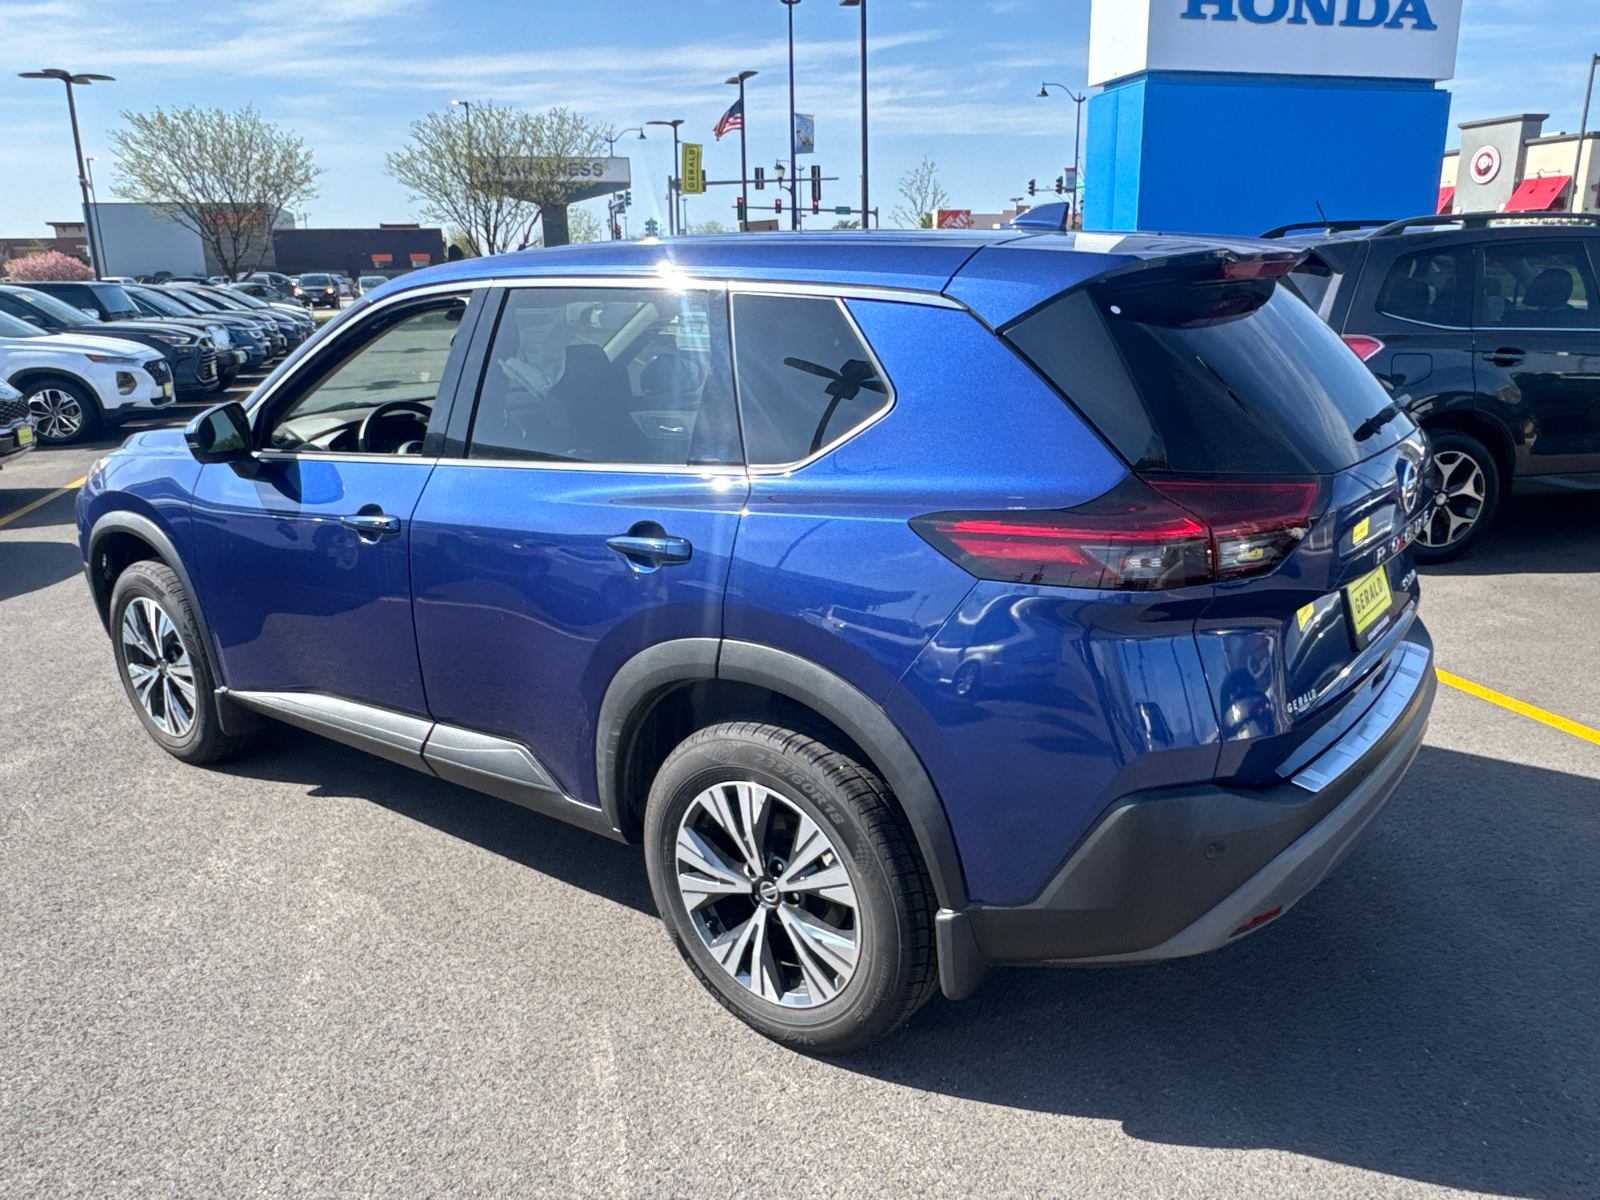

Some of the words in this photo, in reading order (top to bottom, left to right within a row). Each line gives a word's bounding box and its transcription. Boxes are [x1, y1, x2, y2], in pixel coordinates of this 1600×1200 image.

[1181, 0, 1437, 31] HONDA
[687, 149, 695, 187] GERALD
[1354, 576, 1383, 614] GERALD
[1287, 688, 1316, 713] GERALD
[753, 753, 845, 825] 235/60R18
